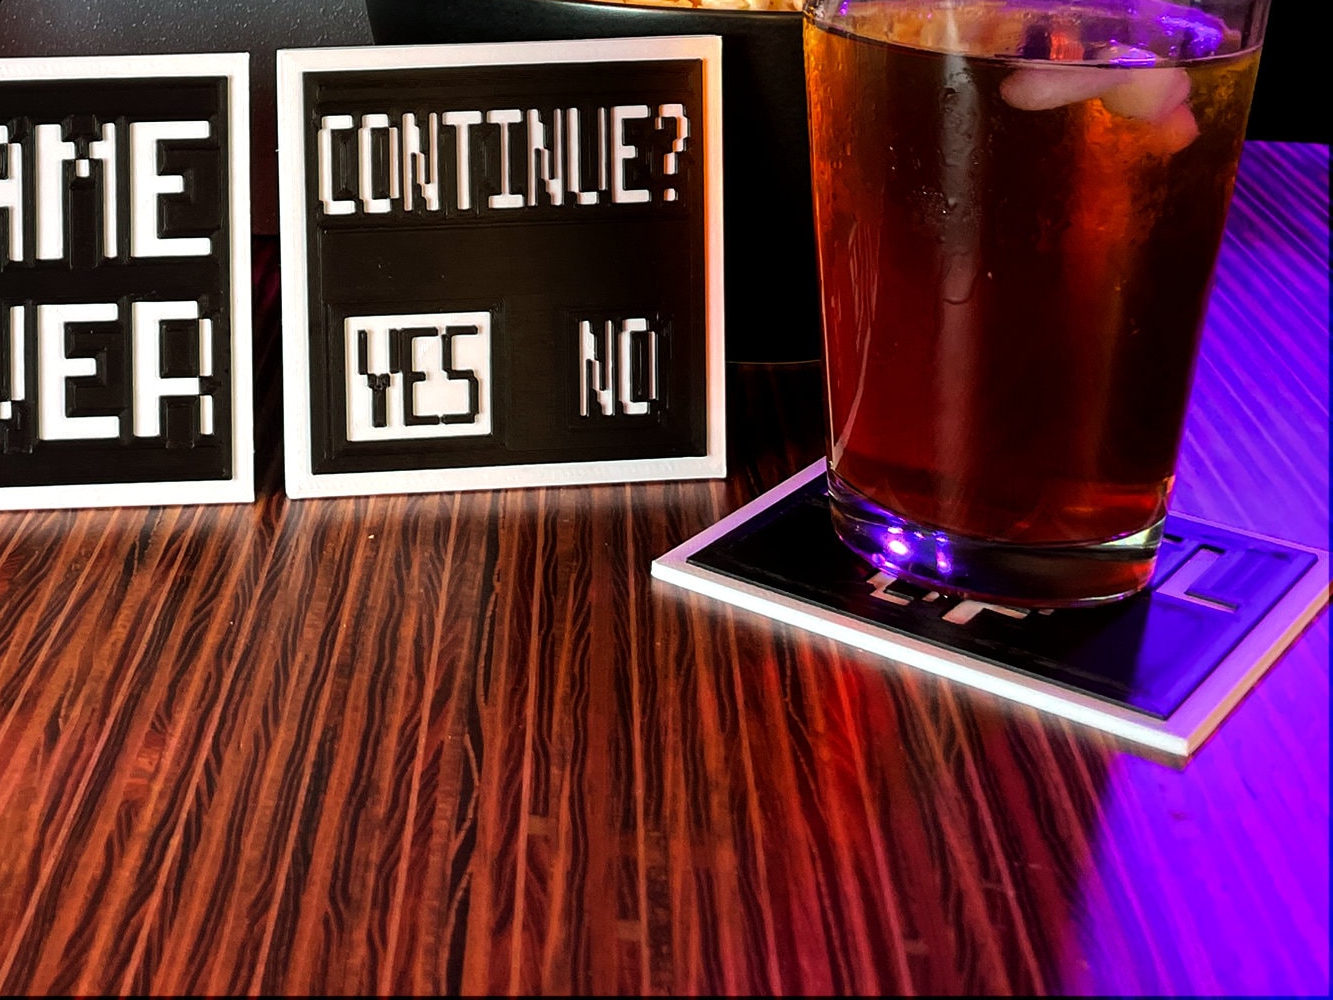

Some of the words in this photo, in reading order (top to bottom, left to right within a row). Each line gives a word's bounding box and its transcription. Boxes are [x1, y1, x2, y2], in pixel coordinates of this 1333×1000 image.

[318, 104, 691, 215] CONTINUE?
[357, 325, 480, 428] YES
[579, 318, 659, 417] NO
